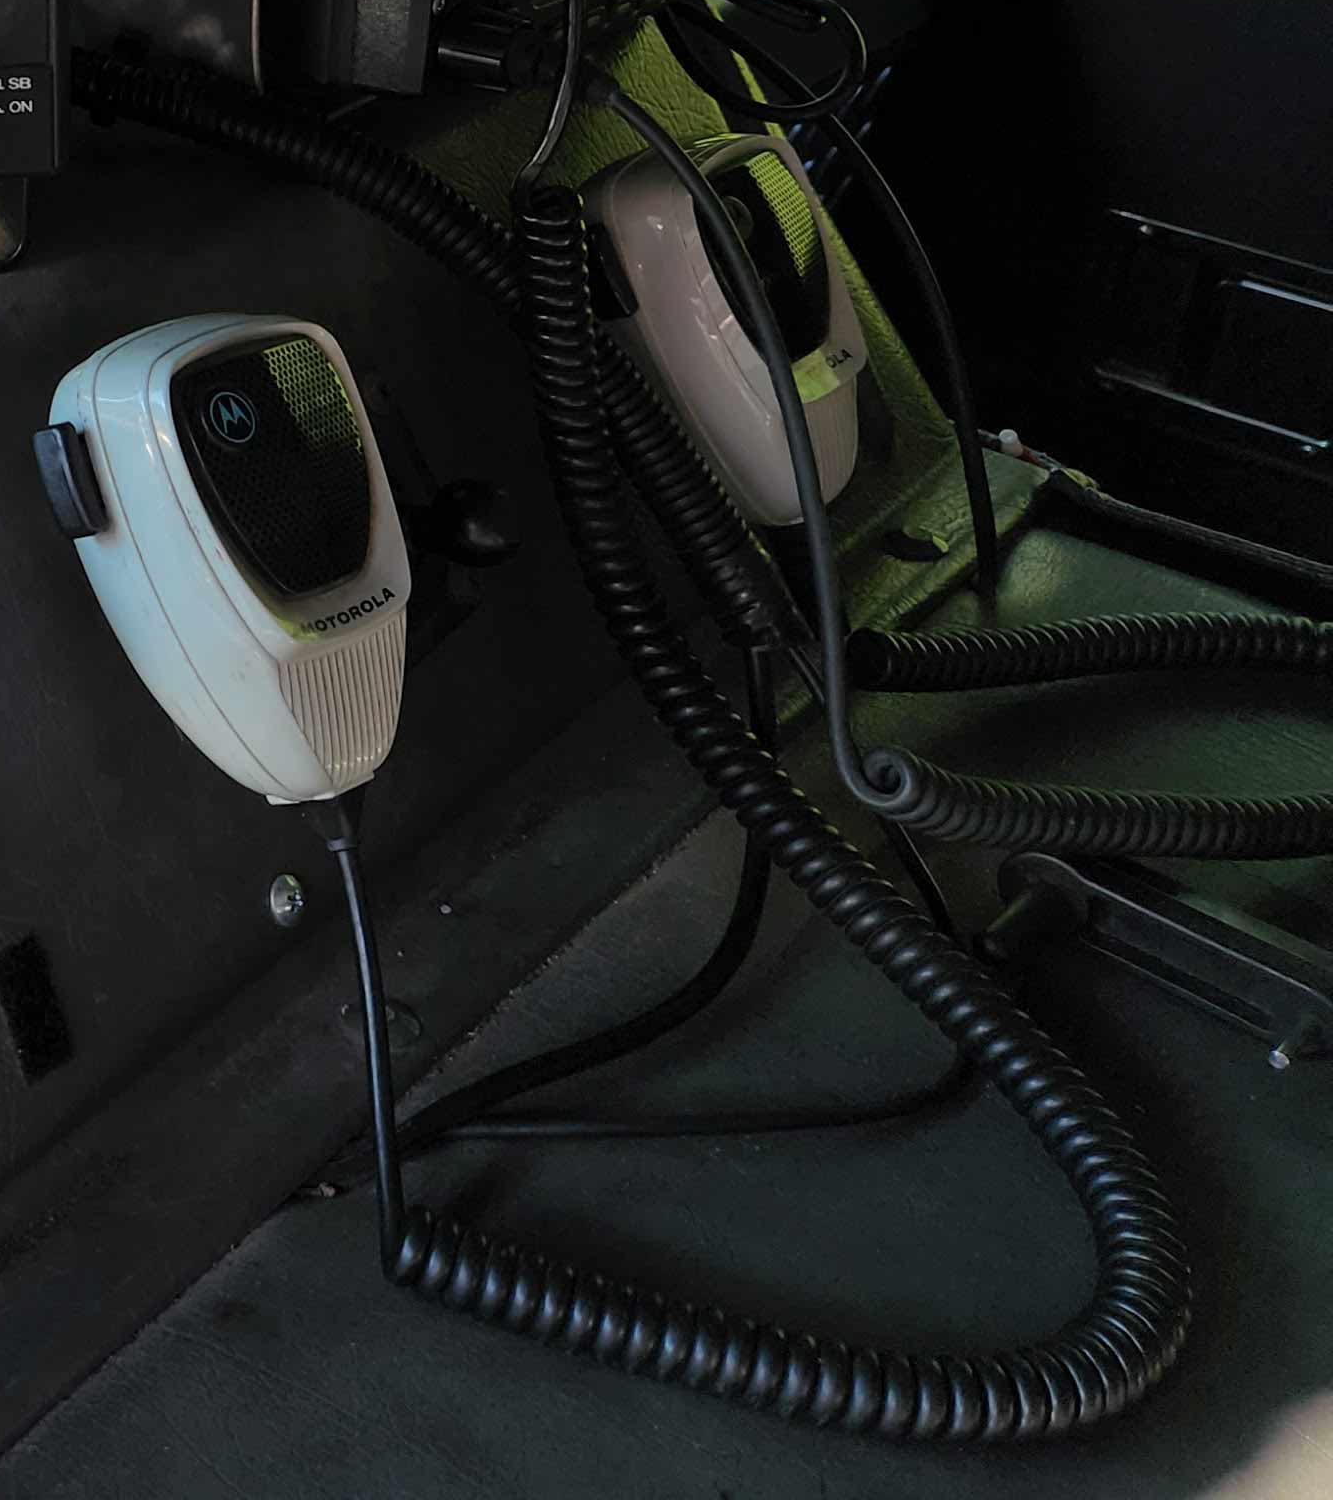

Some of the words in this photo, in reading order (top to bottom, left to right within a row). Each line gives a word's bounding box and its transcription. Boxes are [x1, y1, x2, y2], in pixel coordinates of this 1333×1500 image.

[8, 77, 32, 90] SB
[8, 100, 33, 113] ON
[299, 587, 396, 634] MOTOROLA
